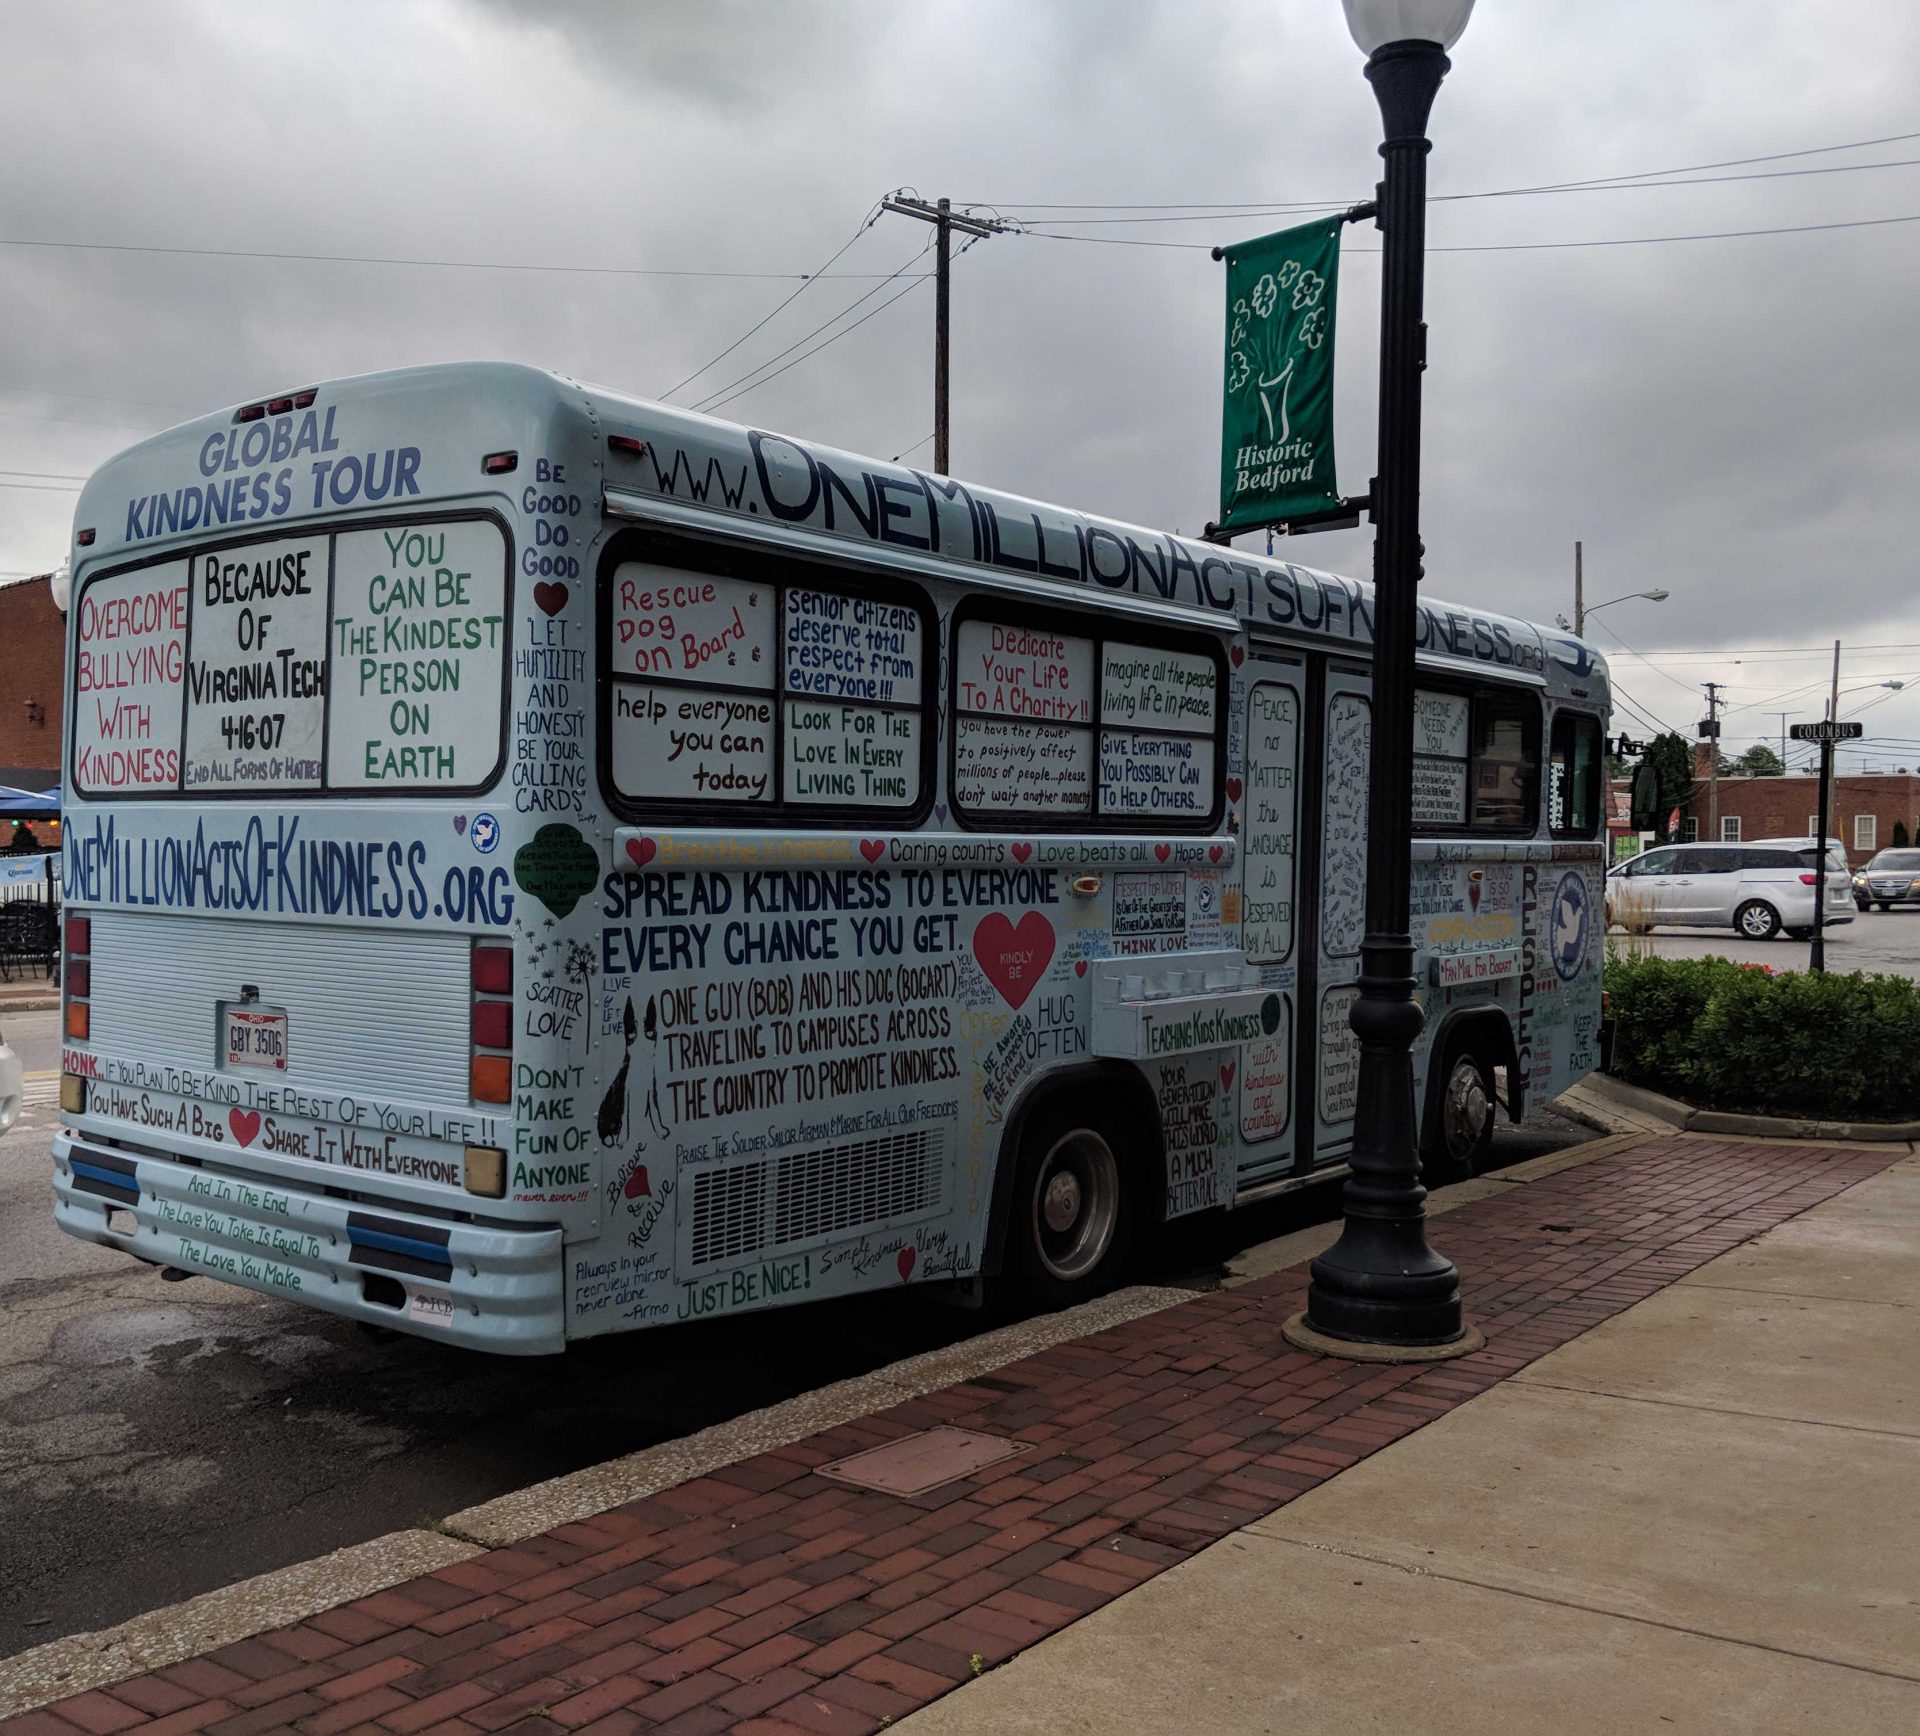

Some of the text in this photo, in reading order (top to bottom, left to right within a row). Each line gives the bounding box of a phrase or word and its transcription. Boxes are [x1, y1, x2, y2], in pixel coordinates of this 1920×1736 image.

[199, 406, 339, 477] GLOBAL
[1234, 436, 1312, 469] Historic
[535, 458, 566, 484] BE
[1234, 458, 1315, 493] Bedford
[126, 446, 421, 542] KINDNESS TOUR
[522, 486, 581, 517] GOOD
[384, 528, 445, 568] YOU
[535, 518, 569, 547] DO
[522, 547, 580, 579] GOOD
[205, 551, 311, 610] BECAUSE
[368, 568, 471, 615] CAN BE
[620, 580, 717, 612] Rescue
[80, 587, 188, 642] OVERCOME
[237, 607, 272, 651] OF
[617, 614, 677, 644] Dog
[334, 615, 503, 656] THE KINDEST
[635, 606, 746, 673] on Board
[788, 617, 905, 654] deserve total
[79, 640, 182, 692] BULLYING
[190, 648, 326, 706] VIRGINIA TECH
[360, 658, 459, 697] PERSON
[515, 649, 586, 682] HUMILITY
[787, 645, 914, 680] respect from
[982, 653, 1070, 690] Your Life
[1105, 658, 1150, 688] imagine
[527, 683, 569, 708] AND
[617, 689, 771, 731] help everyone
[97, 696, 150, 740] WITH
[390, 700, 429, 736] ON
[516, 711, 585, 738] HONESTY
[791, 703, 911, 739] LOOK FOR THE
[1421, 717, 1447, 734] NEEDS
[1798, 723, 1855, 739] COLUMBUS
[364, 740, 454, 780] EARTH
[517, 739, 585, 761] BE YOUR
[668, 729, 764, 761] you can
[793, 735, 904, 768] LOVE EVERY
[980, 742, 1077, 762] positively affect
[1132, 735, 1192, 760] EVERYTHING
[77, 745, 178, 786] KINDNESS
[511, 762, 586, 788] CALLING
[957, 763, 998, 780] millions
[1125, 758, 1176, 786] POSSIBLY
[1247, 760, 1292, 789] MATTER
[693, 763, 768, 801] today
[796, 768, 907, 798] LIVING THING
[991, 786, 1059, 806] wait another
[1121, 786, 1148, 808] HELP
[890, 838, 1005, 866] Caring counts
[1037, 841, 1127, 863] Love beats
[1175, 842, 1205, 866] Hope
[603, 872, 732, 919] SPREAD
[744, 870, 891, 913] KINDNESS
[902, 869, 934, 907] TO
[942, 869, 1060, 907] EVERYONE
[1243, 894, 1291, 924] DESERVED
[602, 923, 711, 974] EVERY
[724, 918, 839, 966] CHANCE
[850, 915, 903, 957] YOU
[1000, 950, 1034, 964] KINDLY
[1112, 935, 1189, 955] THINK LOVE
[1444, 953, 1513, 982] FAN BOGART
[526, 982, 584, 1017] SCATTER
[660, 967, 893, 1028] ONE GUY AND HIS DOG
[1038, 994, 1075, 1028] HUG
[248, 1015, 264, 1024] OHIO
[526, 1010, 577, 1040] LOVE
[1143, 1014, 1192, 1054] TEACHING
[1573, 1013, 1592, 1031] KEEP
[230, 1025, 283, 1057] GBY 3506
[663, 1006, 951, 1072] TRAVELING TO CAMPUSES ACROSS
[1026, 1026, 1086, 1060] OFTEN
[517, 1063, 584, 1089] DON'T
[1570, 1052, 1592, 1072] FAITH
[117, 1059, 425, 1136] YOU PLAN KIND THE REST YOUR
[666, 1051, 888, 1124] THE COUNTRY PROMOTE
[516, 1094, 575, 1121] MAKE
[110, 1088, 462, 1188] HAVE SUCH BIG SHARE WITH EVERYONE
[515, 1125, 592, 1155] FUN OF
[676, 1143, 709, 1165] PRAISE
[188, 1174, 260, 1207] And The
[513, 1161, 590, 1189] ANYONE
[606, 1141, 647, 1216] Believe
[156, 1199, 303, 1258] The Love You Equal
[627, 1179, 675, 1250] Receive
[179, 1238, 201, 1263] The
[915, 1225, 949, 1252] Very
[575, 1262, 617, 1293] Always
[633, 1267, 671, 1286] mirror
[677, 1255, 812, 1320] JUST BE NICE!
